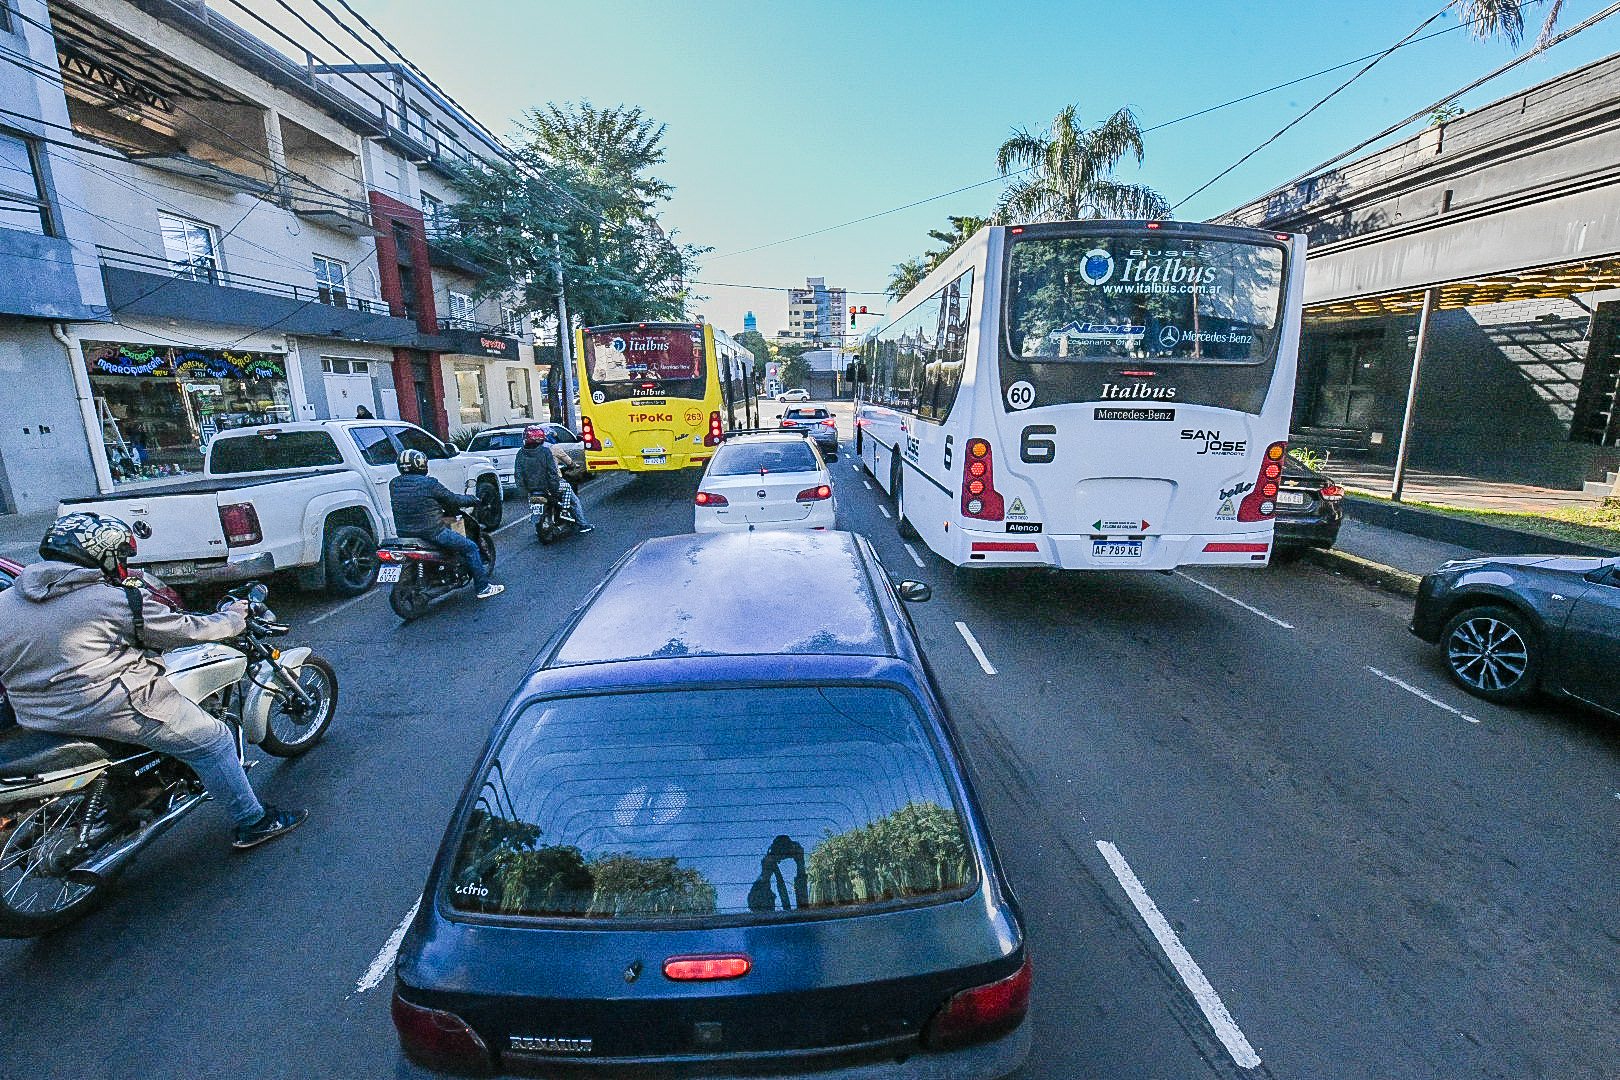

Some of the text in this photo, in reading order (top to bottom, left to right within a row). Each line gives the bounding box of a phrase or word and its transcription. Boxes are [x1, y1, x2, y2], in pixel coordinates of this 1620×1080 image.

[1129, 249, 1212, 259] BUSES
[1120, 258, 1217, 283] Italbus
[1103, 282, 1222, 294] www.italbus.com.ar
[1182, 330, 1252, 344] Mercedes-Benz
[629, 340, 670, 351] Italbus
[1011, 388, 1031, 403] 60
[1100, 383, 1176, 398] Italbus
[593, 393, 604, 401] 60
[1098, 410, 1171, 420] Mercedes-Benz
[1180, 430, 1220, 440] SAN
[1020, 425, 1057, 464] 6
[1197, 441, 1247, 454] JOSE
[943, 434, 953, 471] 6
[1095, 546, 1140, 555] AF 789 KE
